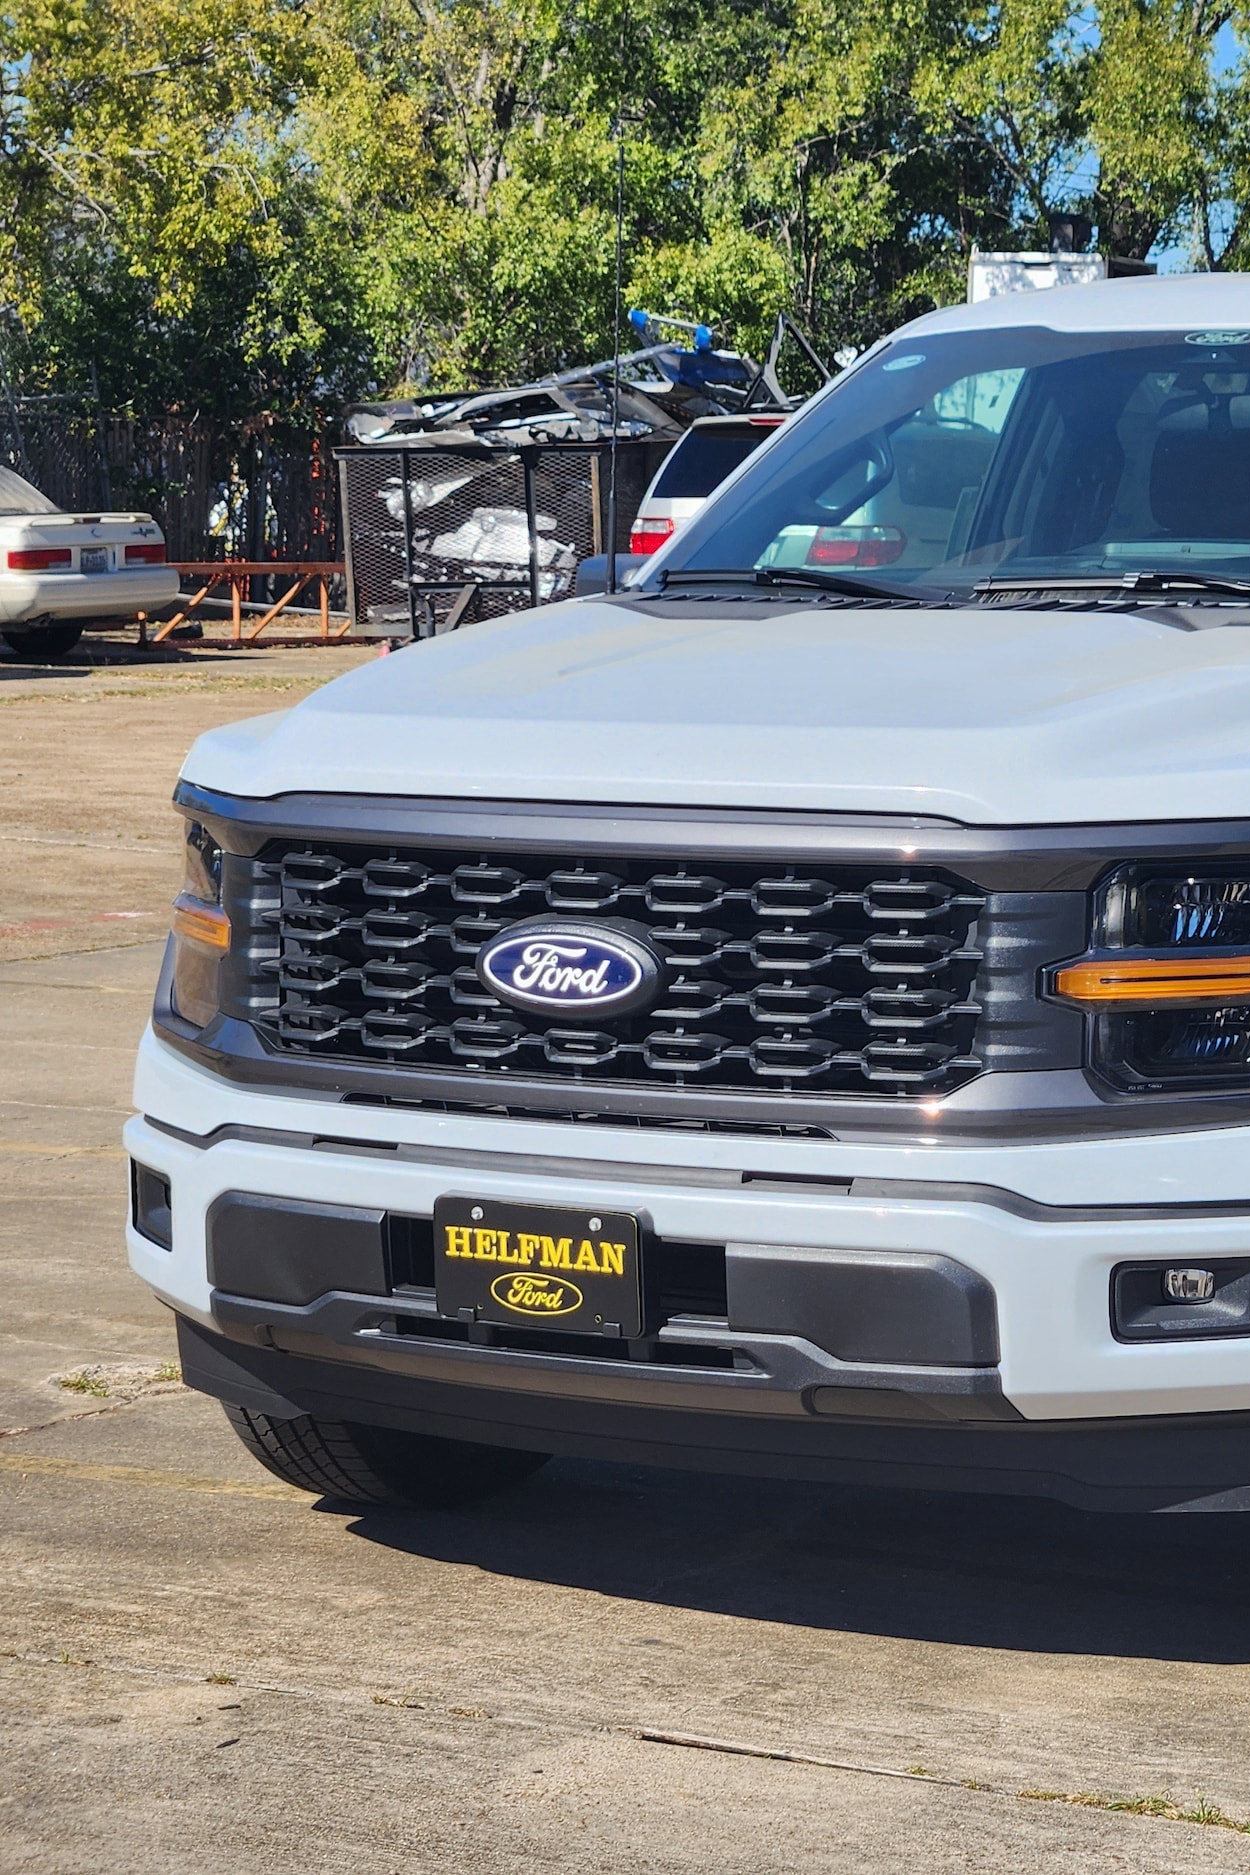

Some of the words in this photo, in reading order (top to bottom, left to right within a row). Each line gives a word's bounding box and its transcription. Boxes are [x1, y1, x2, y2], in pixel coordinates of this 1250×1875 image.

[513, 943, 610, 992] Ford
[445, 1226, 626, 1275] HELFMAN
[507, 1276, 564, 1308] Ford
